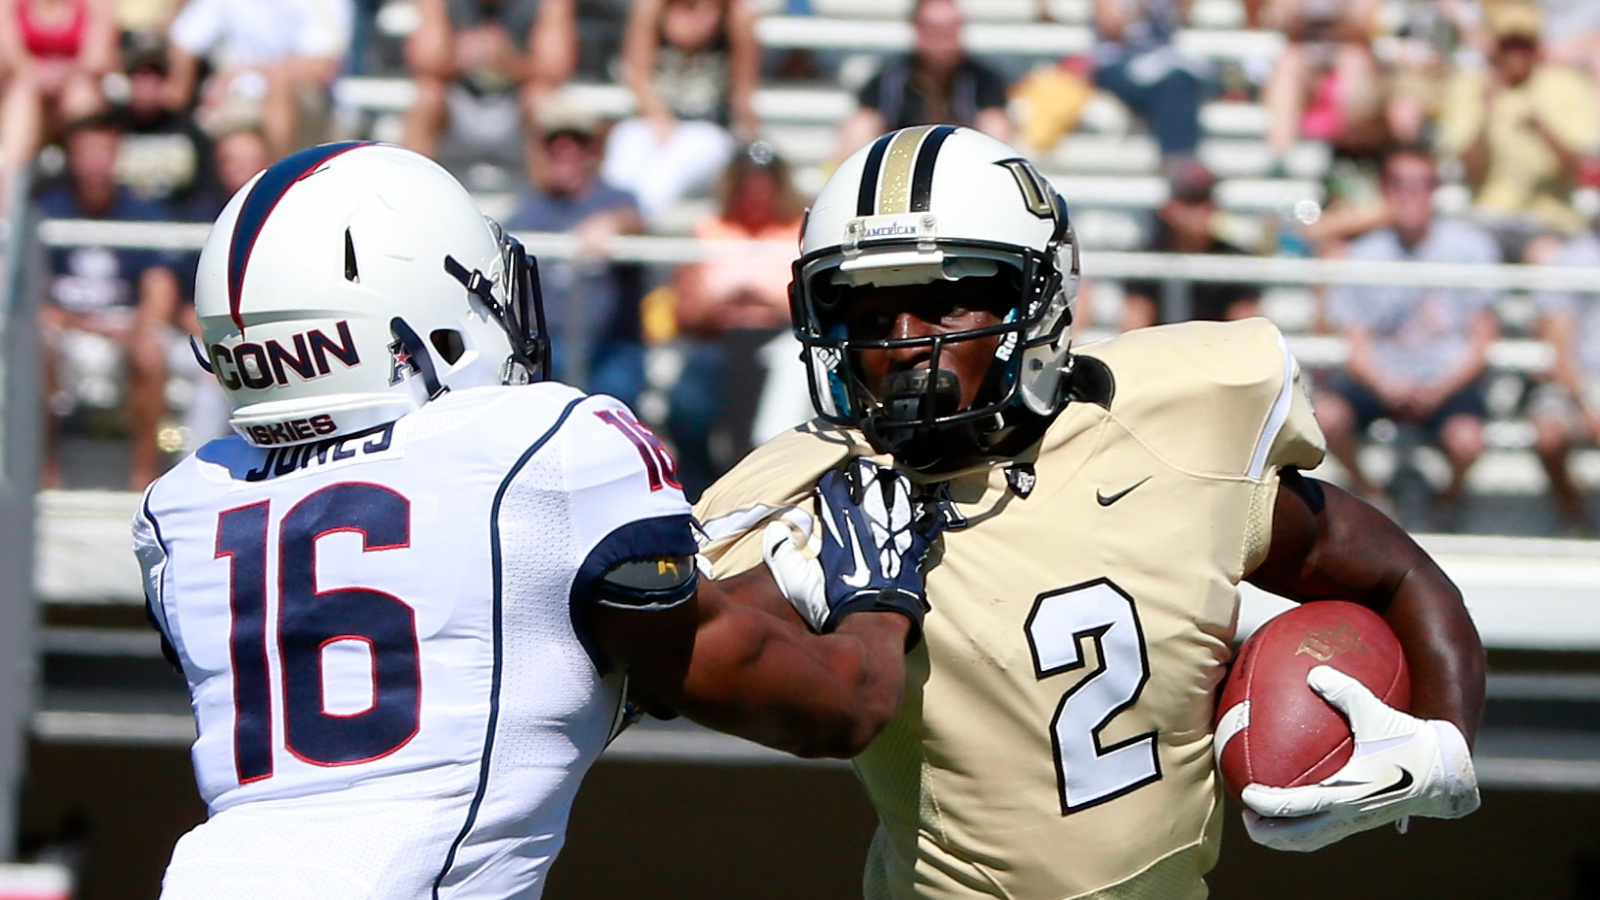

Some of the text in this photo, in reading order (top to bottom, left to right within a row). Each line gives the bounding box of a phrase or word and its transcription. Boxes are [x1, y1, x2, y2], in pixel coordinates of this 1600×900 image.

[866, 222, 917, 237] AMERICAN
[210, 320, 361, 391] CONN
[214, 480, 422, 785] 16
[1023, 576, 1163, 817] 2
